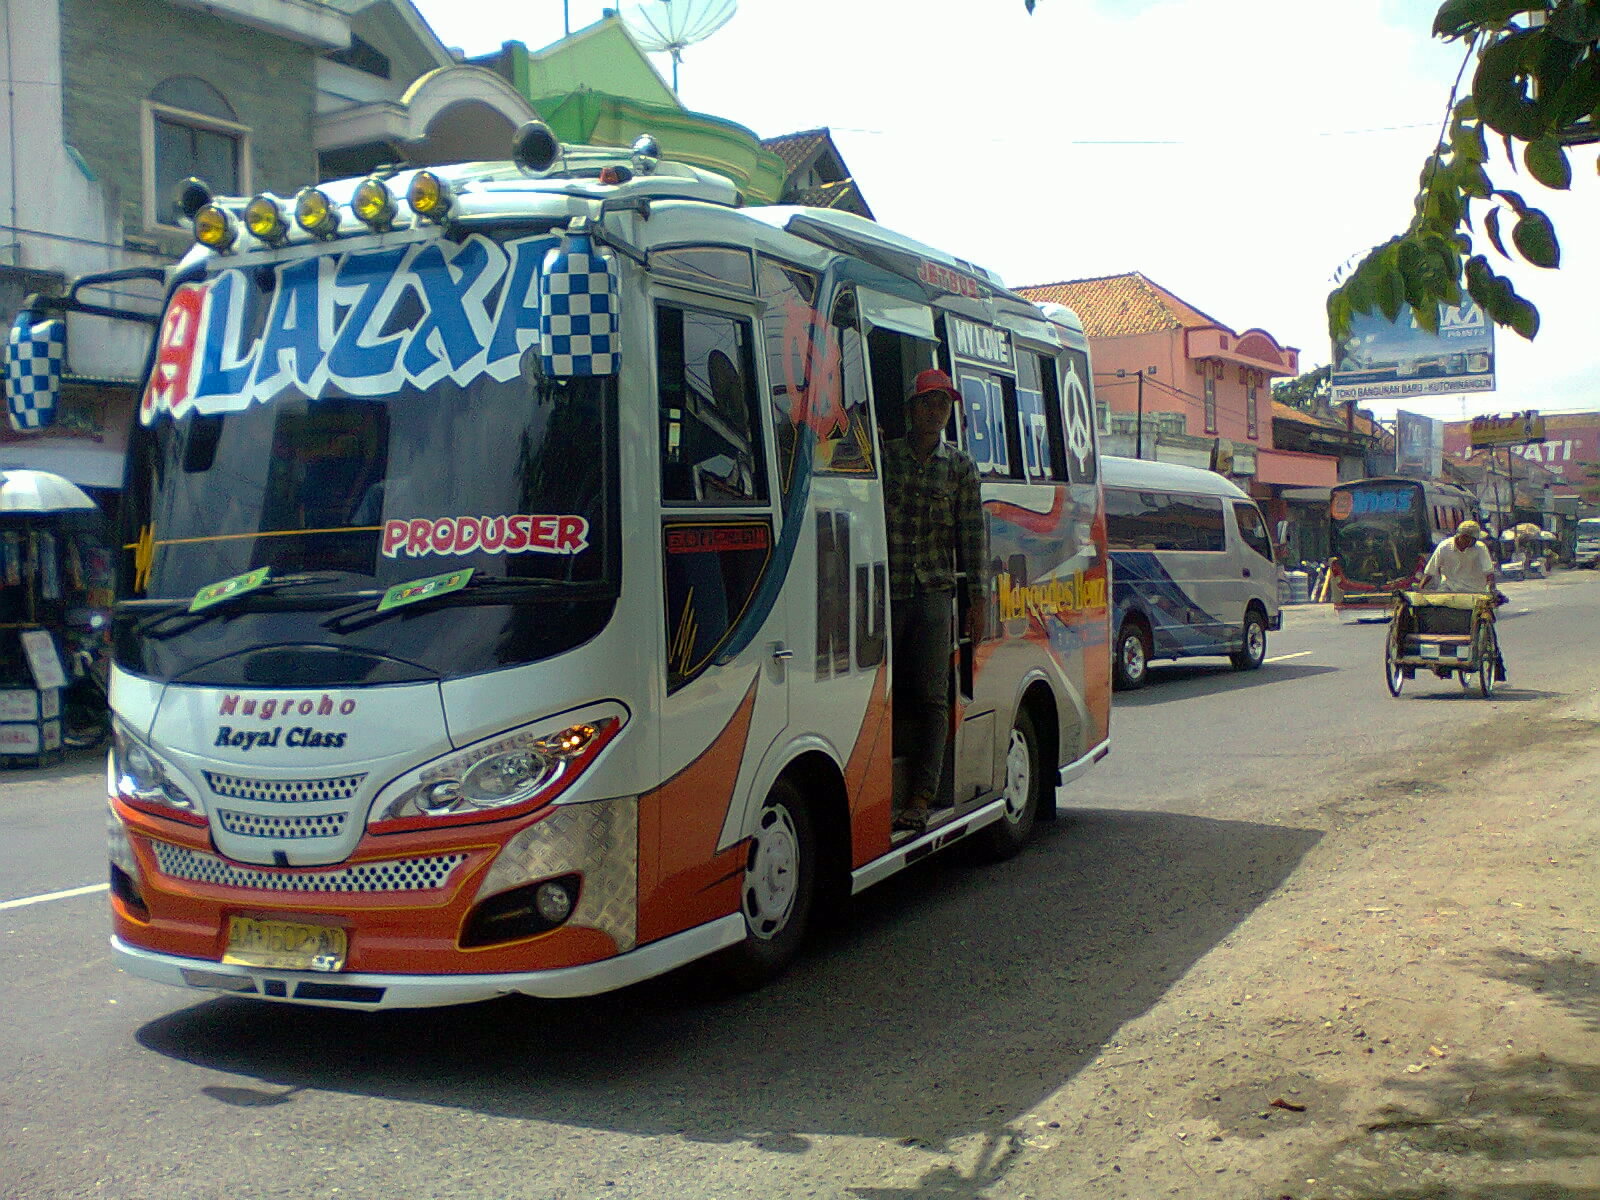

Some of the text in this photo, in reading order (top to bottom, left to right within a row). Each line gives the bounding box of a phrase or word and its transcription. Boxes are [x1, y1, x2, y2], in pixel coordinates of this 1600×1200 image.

[382, 514, 590, 558] PRODUSER
[219, 694, 356, 720] Nugroho
[214, 726, 347, 751] Royal Class
